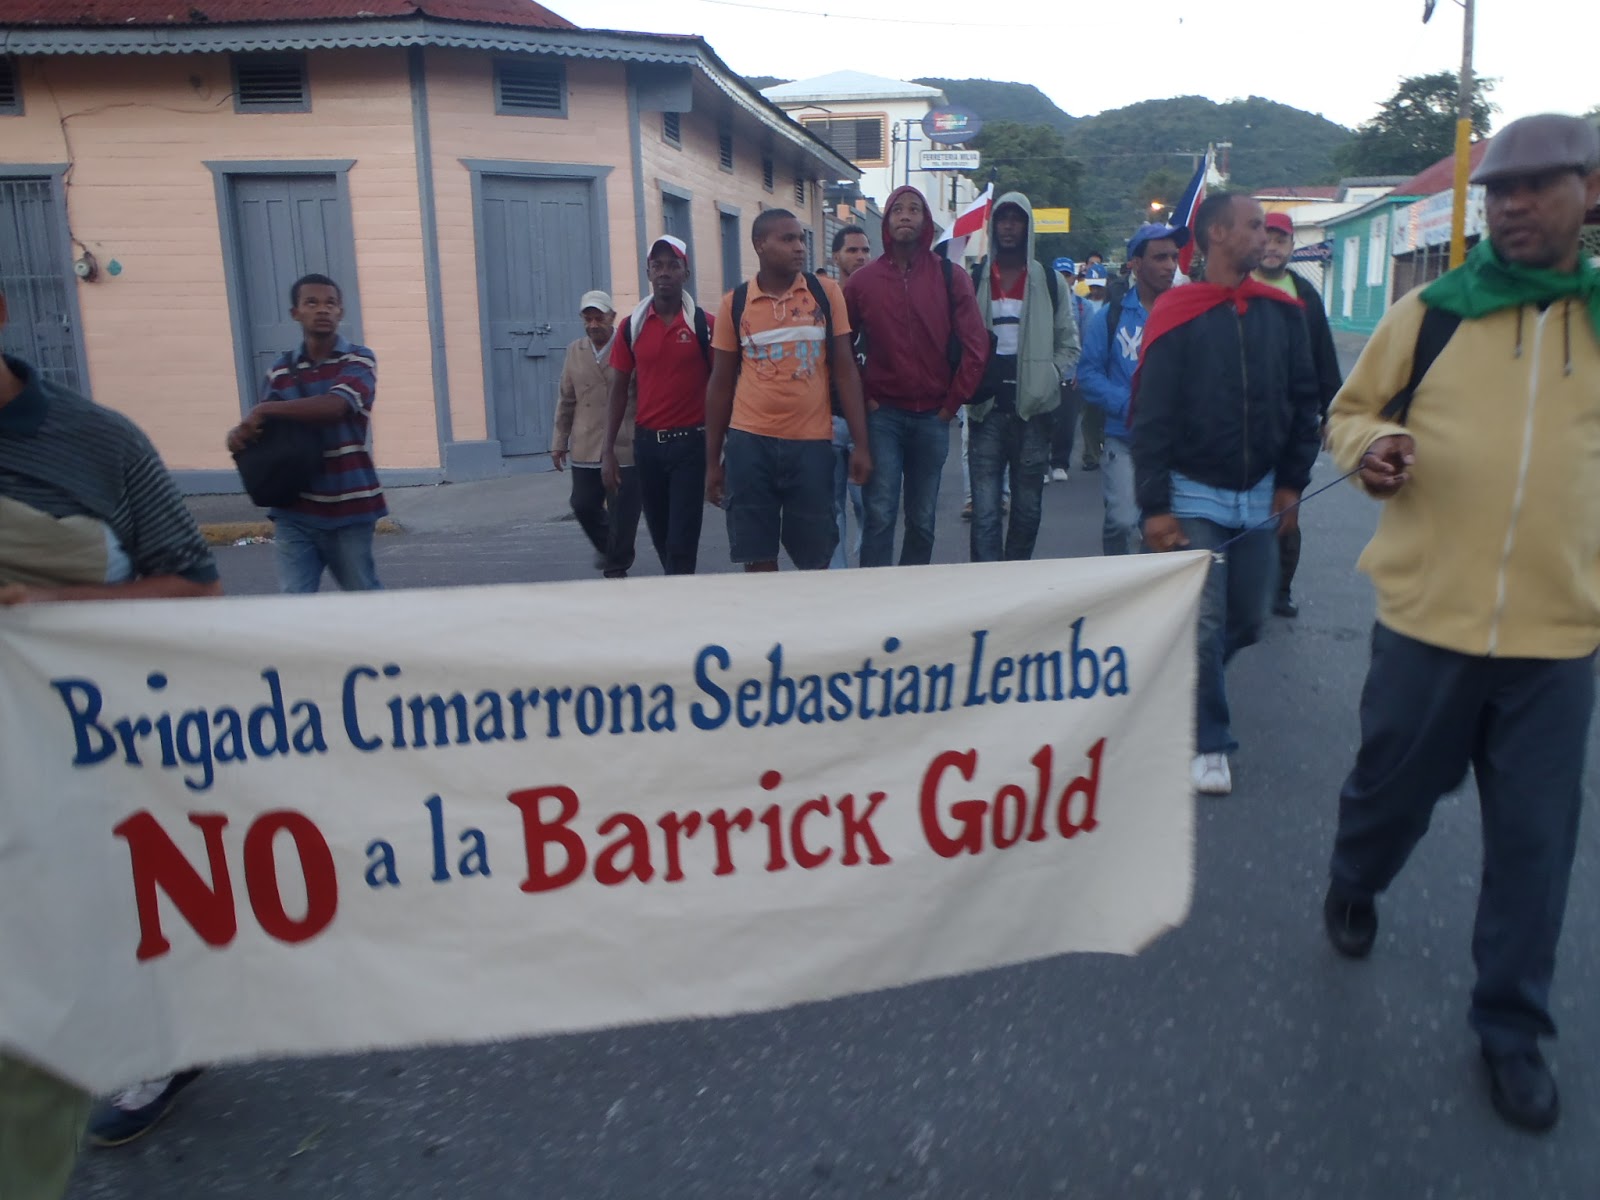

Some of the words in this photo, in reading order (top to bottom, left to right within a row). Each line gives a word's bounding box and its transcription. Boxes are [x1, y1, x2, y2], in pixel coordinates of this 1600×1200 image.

[50, 667, 328, 792] Brigada
[341, 663, 677, 752] Cimarrona
[690, 637, 954, 731] Sebastian
[962, 616, 1129, 707] Lemba
[111, 808, 339, 963] NO
[364, 838, 402, 888] a
[424, 794, 492, 883] la
[920, 737, 1108, 858] Gold
